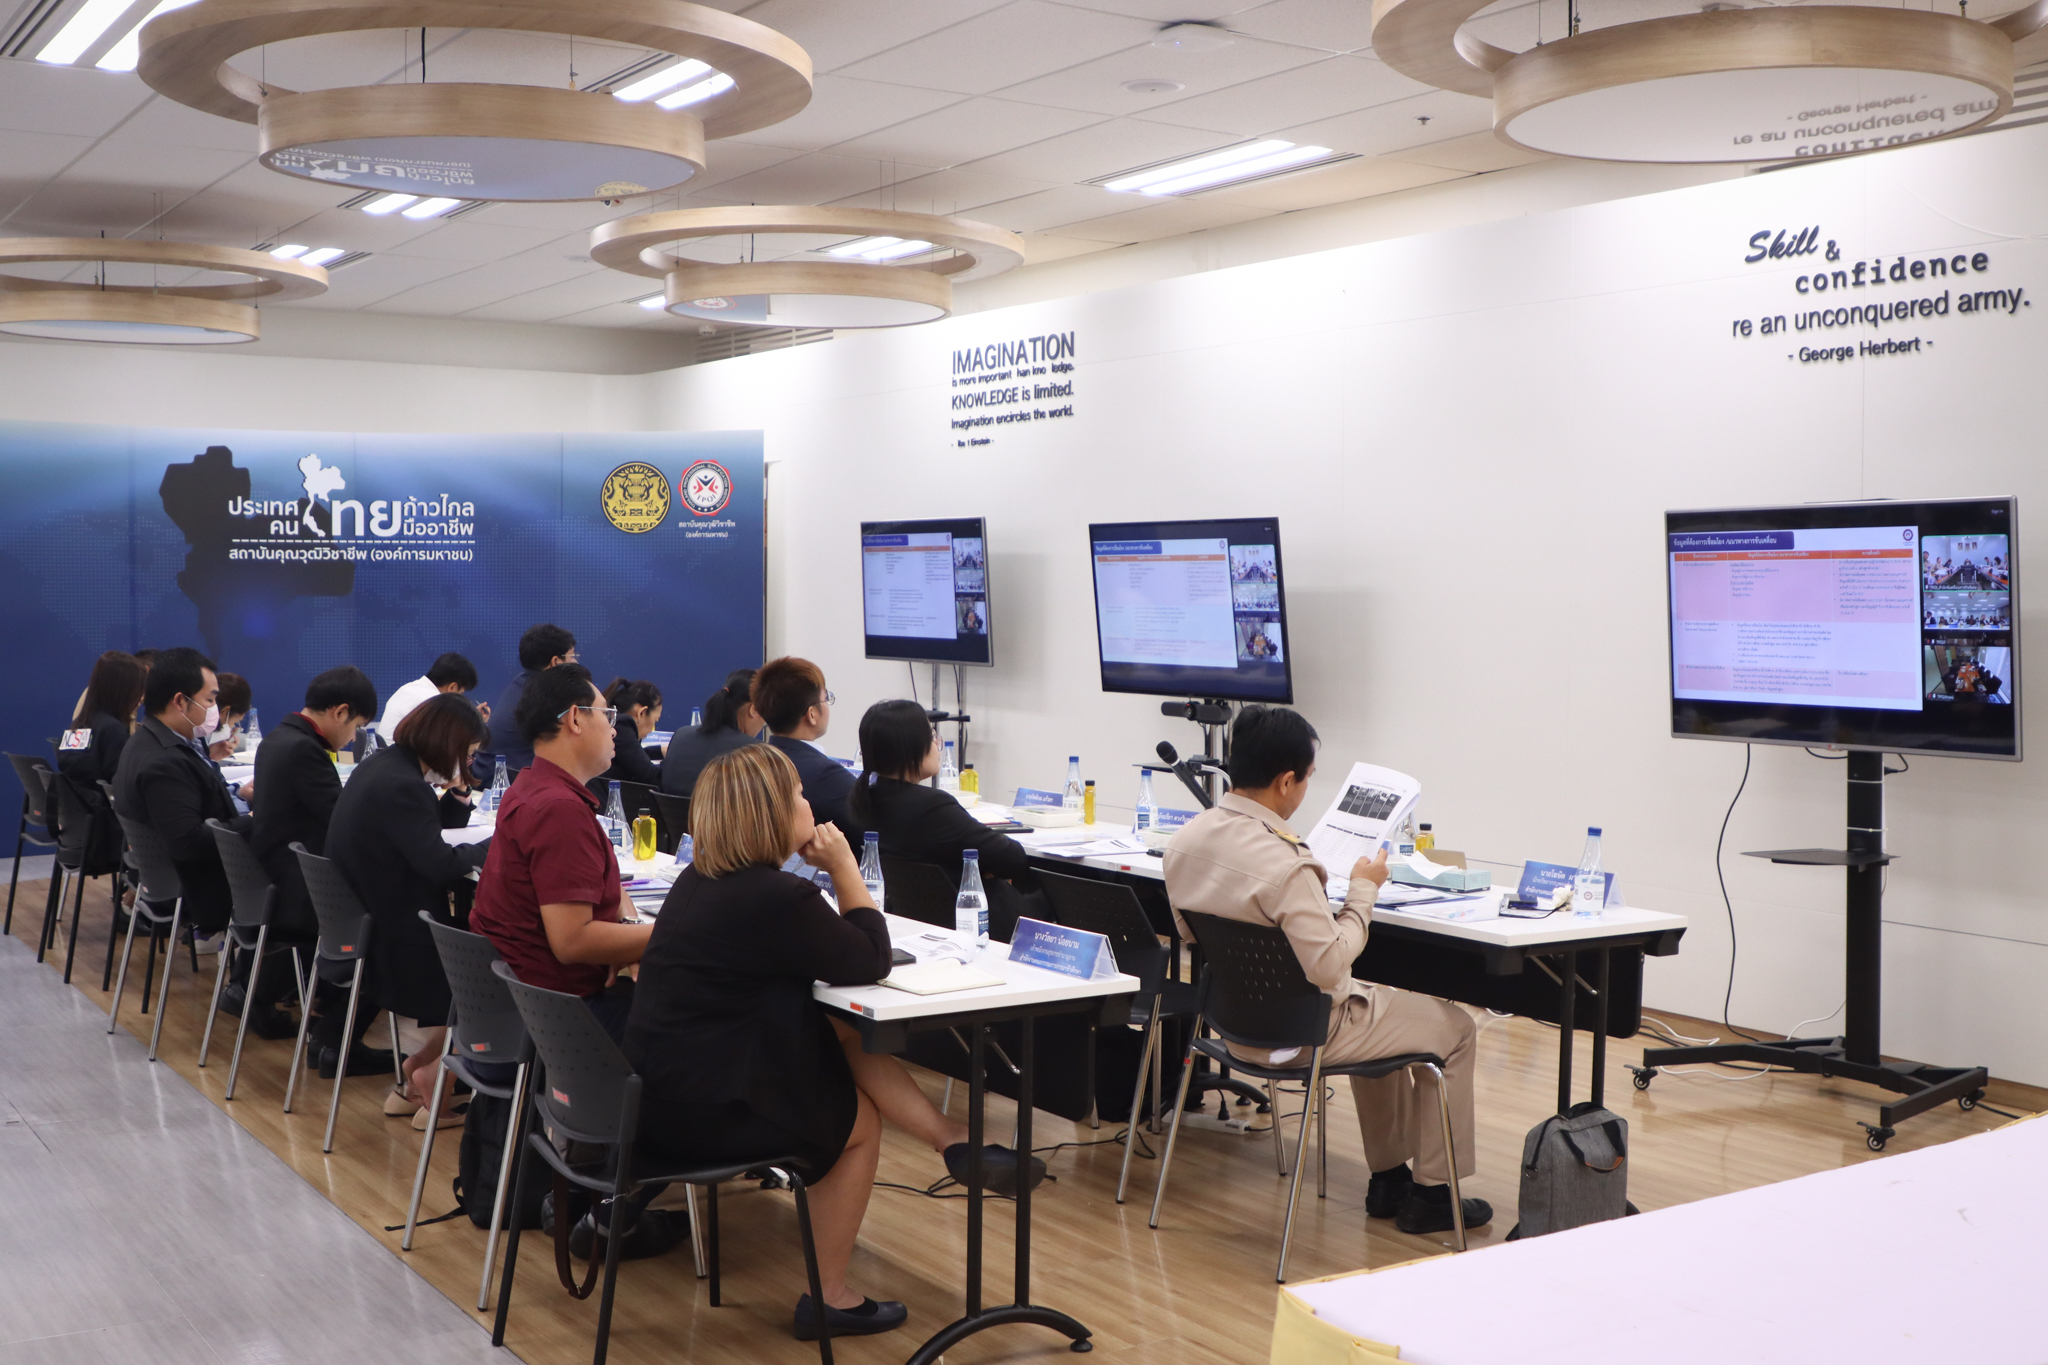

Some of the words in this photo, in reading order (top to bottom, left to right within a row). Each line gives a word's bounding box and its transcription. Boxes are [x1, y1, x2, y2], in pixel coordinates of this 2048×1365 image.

[1745, 225, 1819, 263] Skill
[1825, 240, 1840, 261] &
[1795, 252, 1988, 293] confidence
[1733, 317, 1752, 337] re
[1760, 314, 1786, 334] an
[1795, 290, 1949, 330] unconquered
[1957, 288, 2030, 314] army.
[952, 331, 1075, 374] IMAGINATION
[1799, 346, 1854, 363] George
[1859, 337, 1920, 357] Herbert
[952, 377, 957, 387] is
[959, 376, 976, 386] more
[978, 370, 1011, 384] important
[952, 387, 1018, 410] KNOWLEDGE
[1022, 386, 1030, 401] is
[1034, 380, 1074, 399] limited.
[952, 415, 994, 430] Imagination
[996, 410, 1031, 424] encircles
[1033, 408, 1046, 419] the
[1049, 405, 1074, 418] world.
[228, 496, 299, 516] ประเทศ
[403, 494, 474, 516] ก้าวไกล
[697, 494, 717, 503] TPQI
[270, 518, 299, 535] คน
[403, 518, 474, 536] มืออาชีพ
[229, 546, 367, 564] สถาบันคุณวุฒิวิชาชีพ
[370, 547, 473, 562] (องค์การมหาชน)
